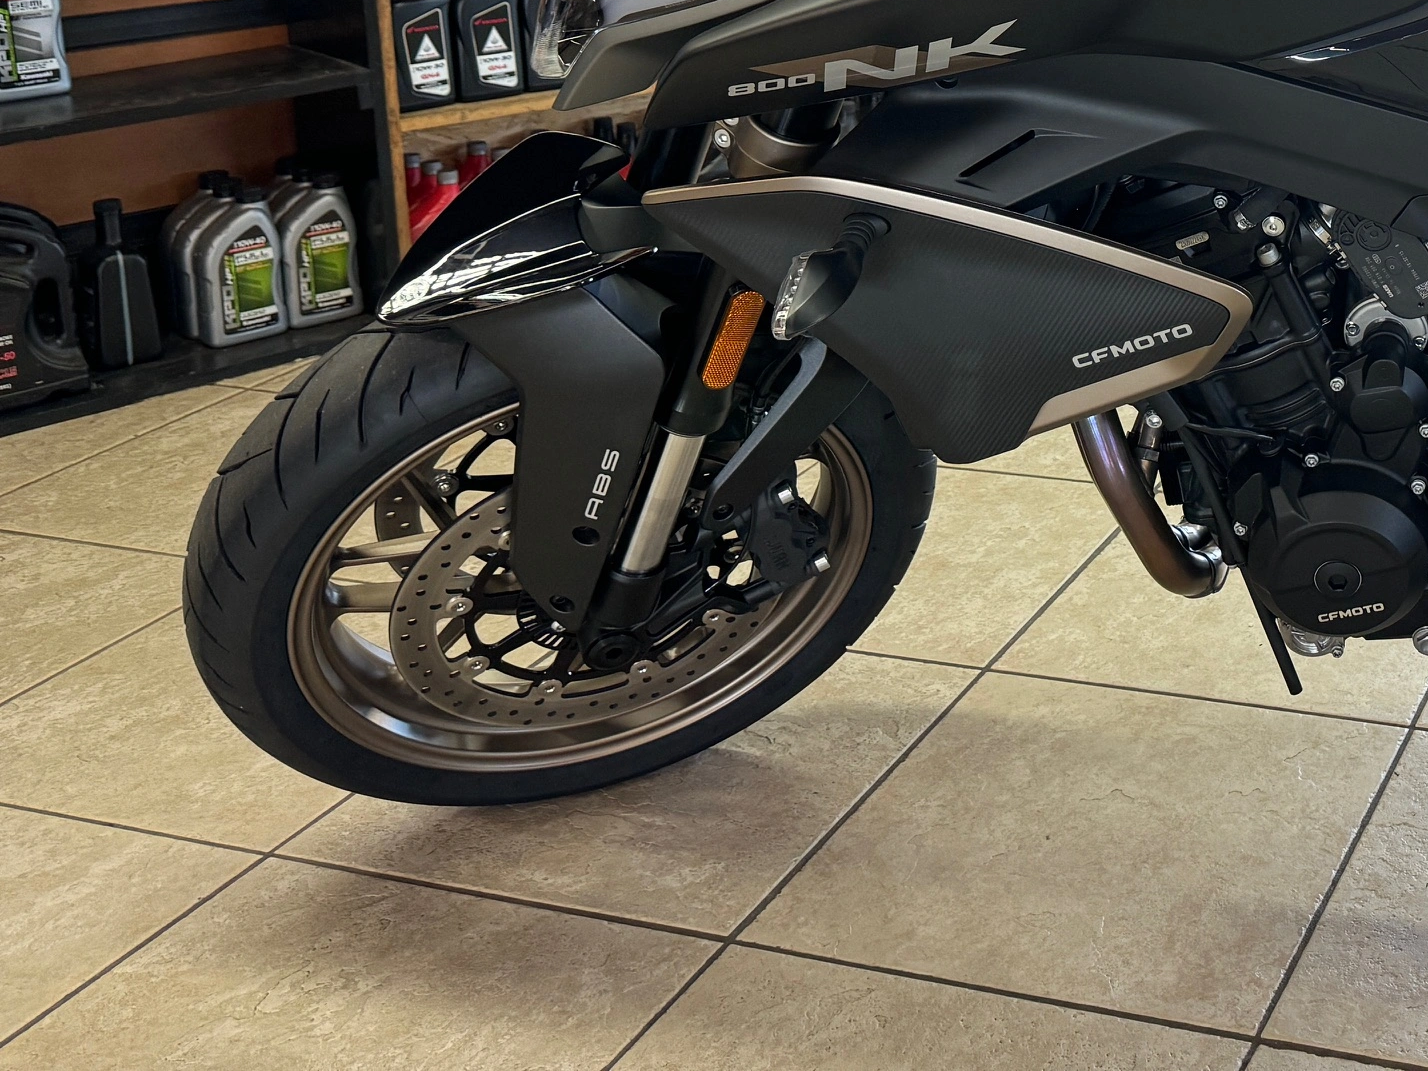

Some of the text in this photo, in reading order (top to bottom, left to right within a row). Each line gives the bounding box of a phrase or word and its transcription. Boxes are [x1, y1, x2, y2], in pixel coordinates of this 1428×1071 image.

[11, 0, 42, 7] SEMI
[728, 19, 1027, 97] 800 NK
[1071, 323, 1193, 368] CFMOTO
[584, 448, 620, 520] ABS
[1317, 602, 1385, 623] CFMOTO
